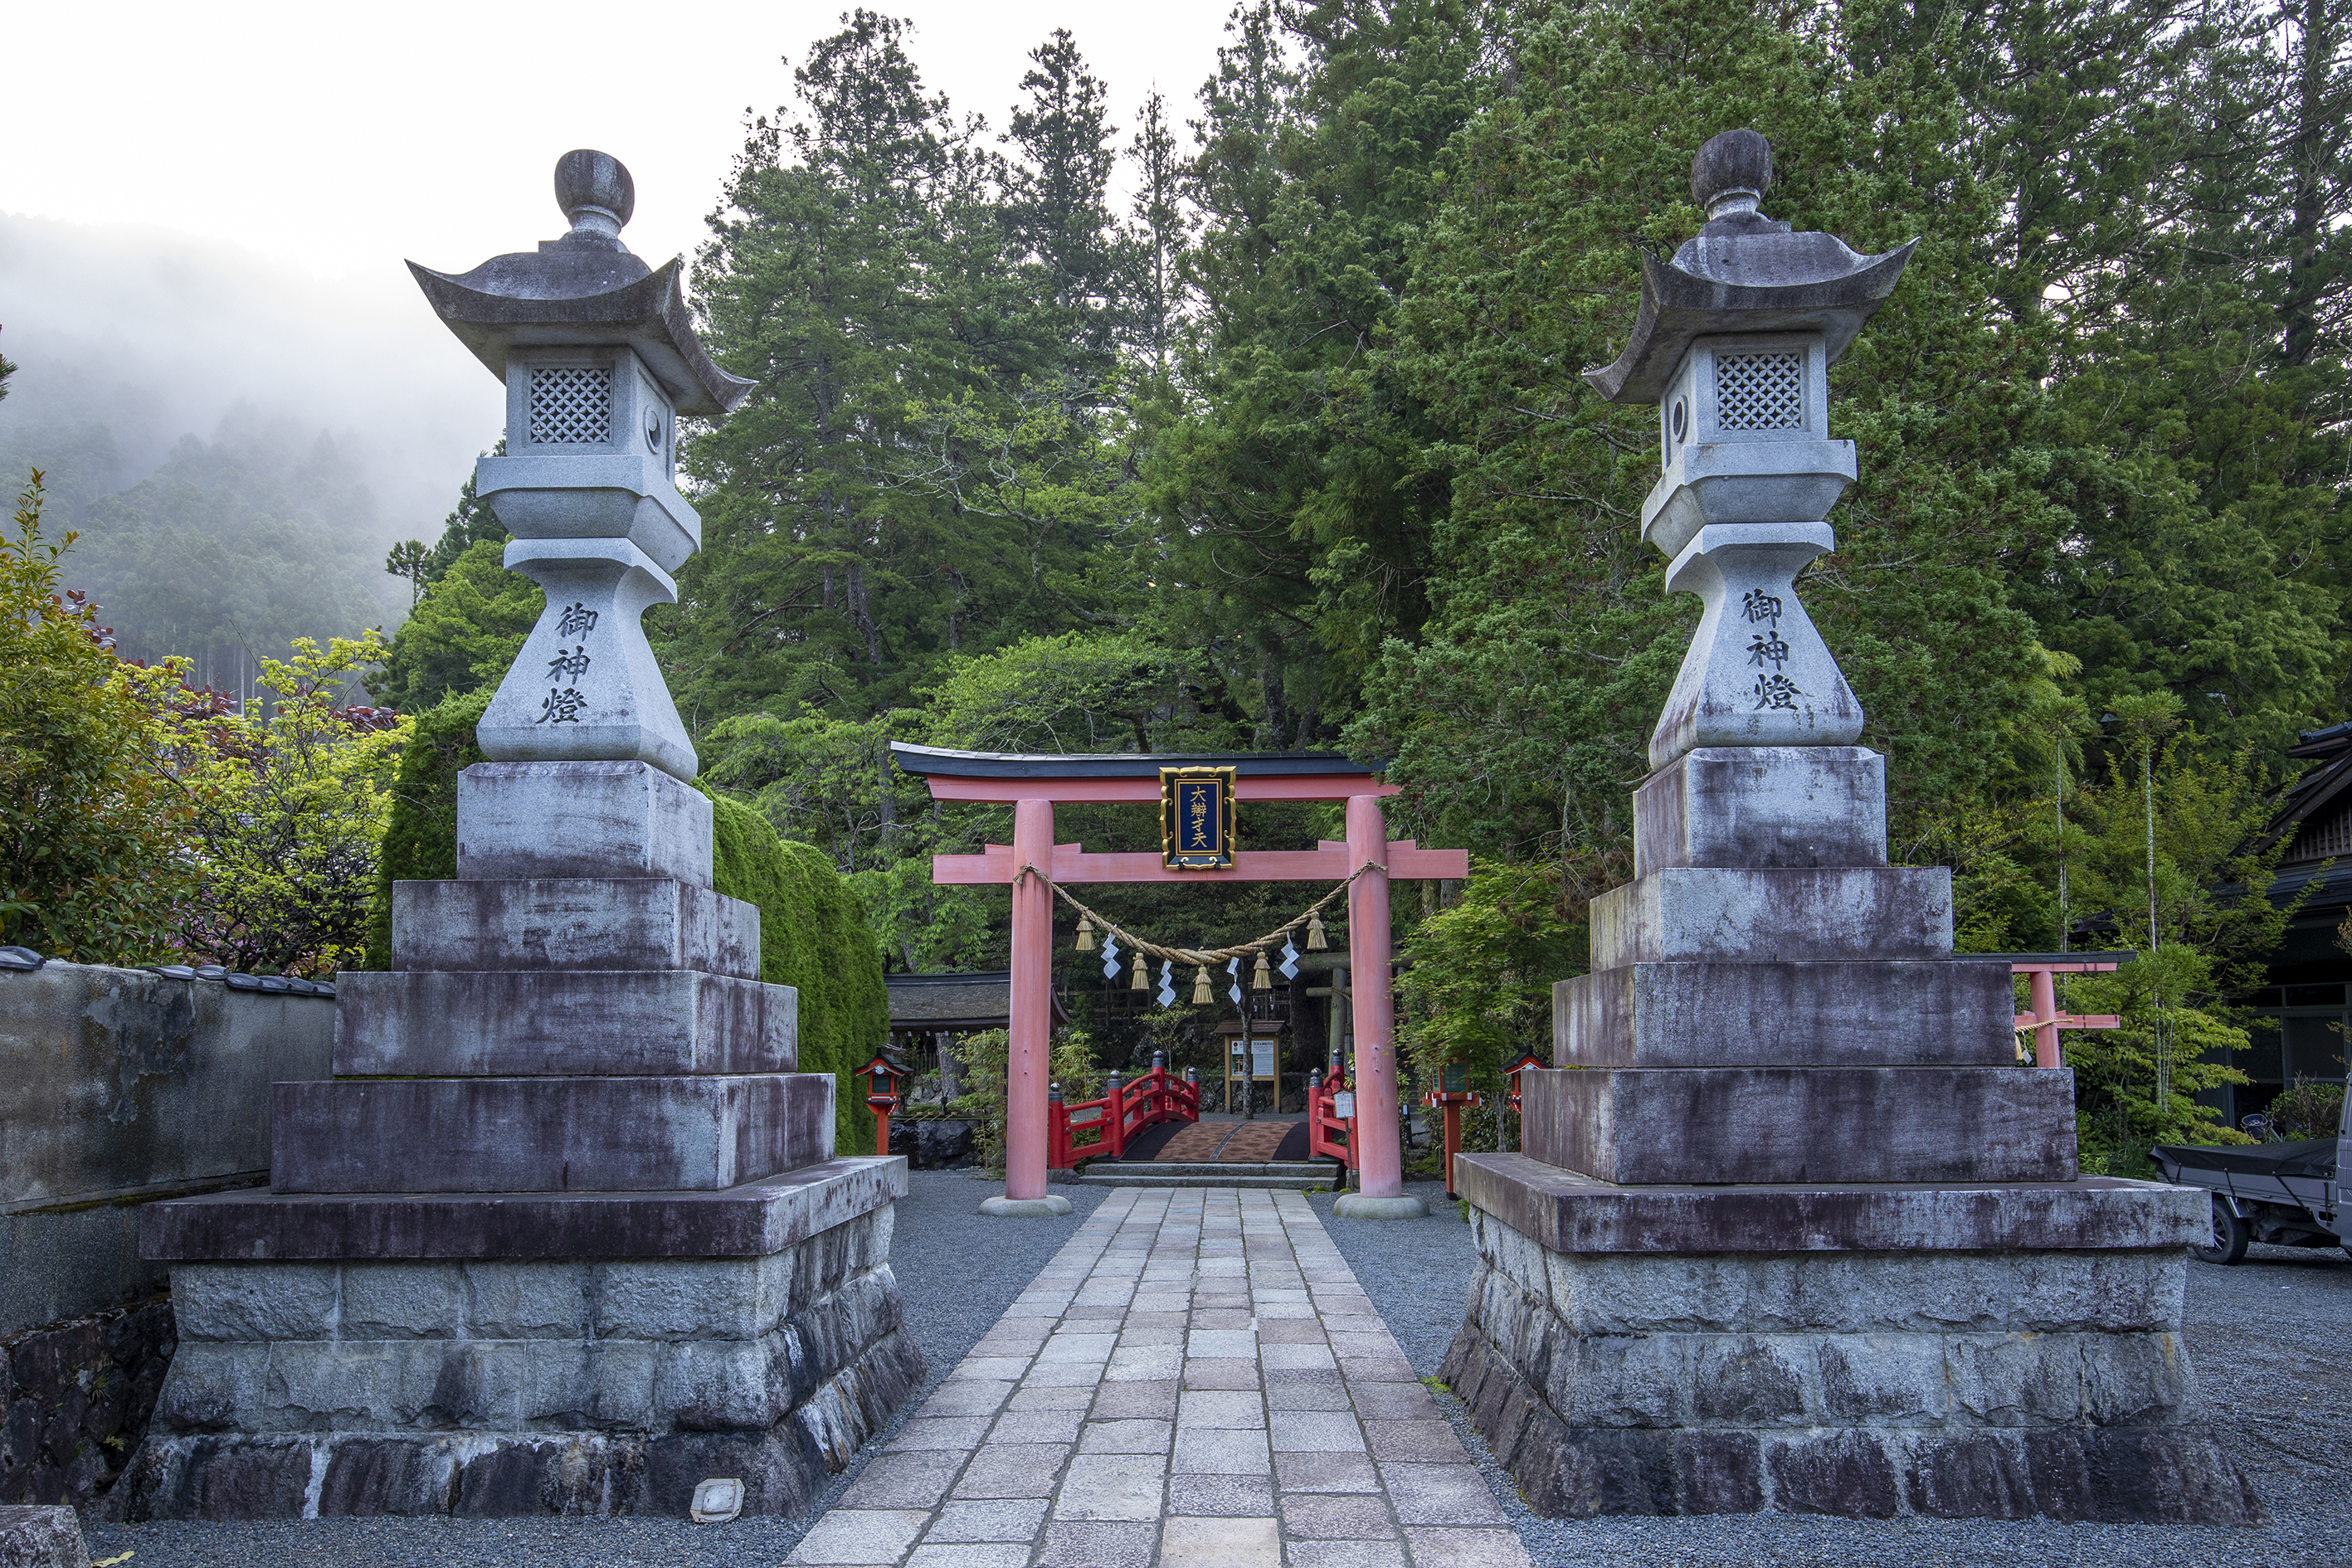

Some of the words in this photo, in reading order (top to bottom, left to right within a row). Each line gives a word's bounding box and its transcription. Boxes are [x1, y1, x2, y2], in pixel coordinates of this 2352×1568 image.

[535, 601, 599, 724] 御神燈
[1741, 588, 1802, 711] 御神燈
